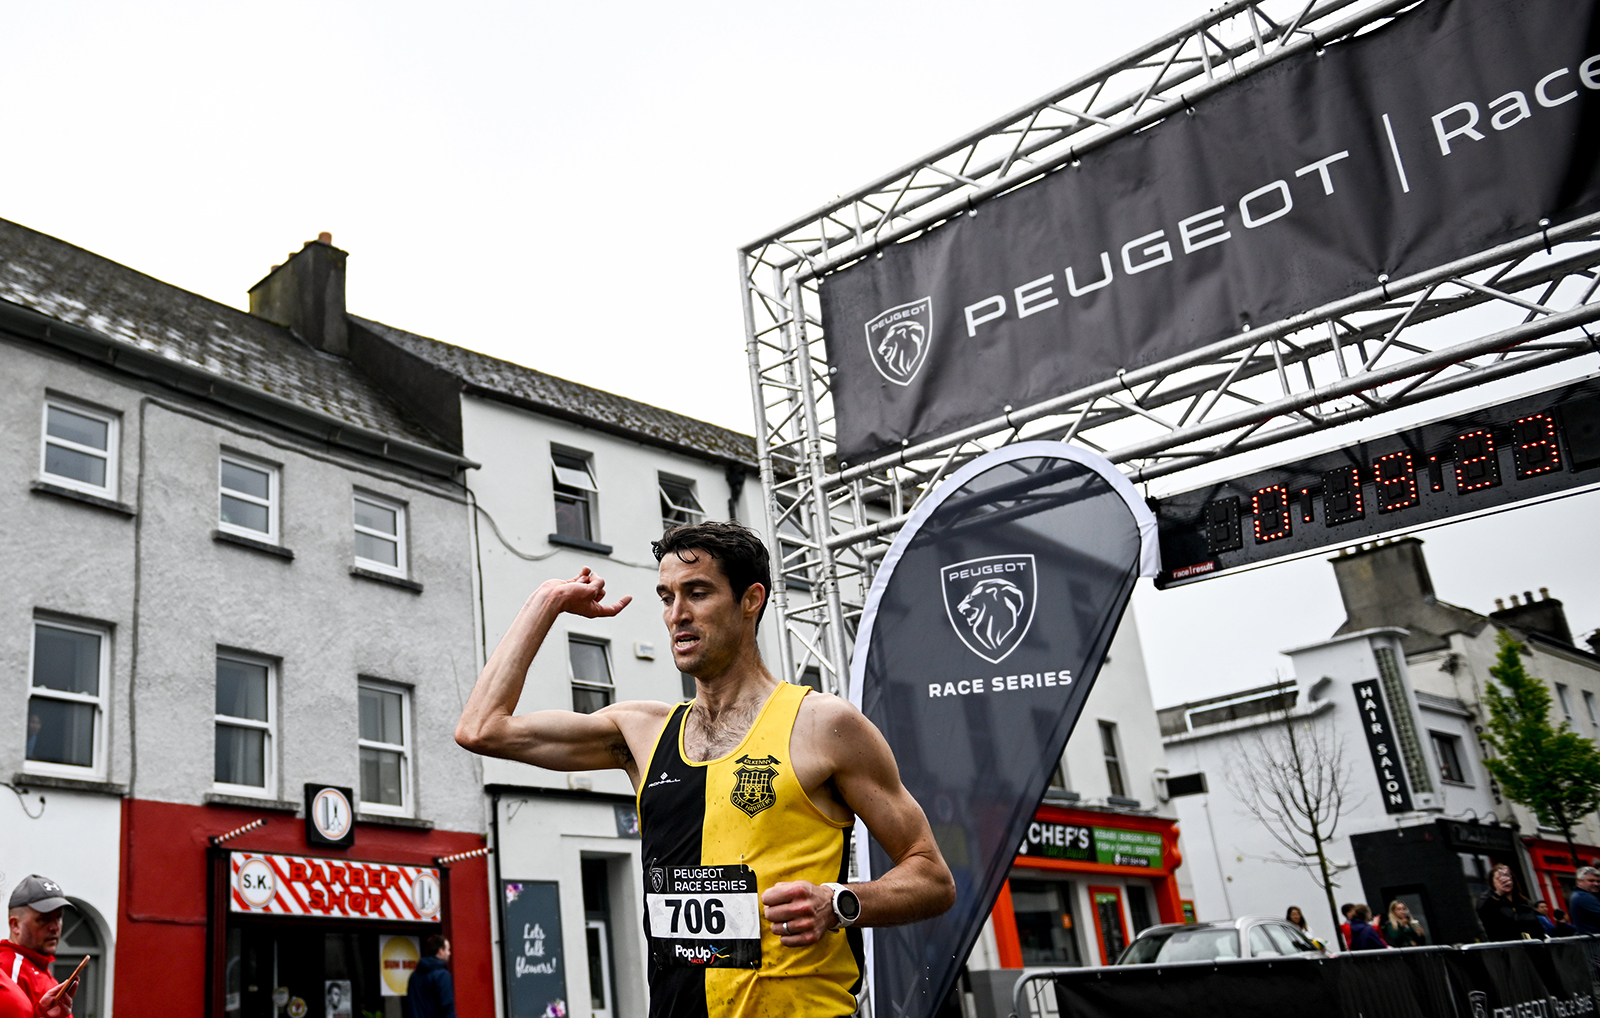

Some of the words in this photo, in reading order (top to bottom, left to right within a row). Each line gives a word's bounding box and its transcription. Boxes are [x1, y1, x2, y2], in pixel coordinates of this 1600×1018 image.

[964, 150, 1350, 338] PEUGEOT
[871, 304, 927, 333] PEUGEOT
[949, 562, 1027, 582] PEUGEOT
[928, 679, 985, 697] RACE
[991, 670, 1072, 692] SERIES
[1360, 686, 1383, 734] HAIR
[1376, 743, 1403, 805] SALON
[1028, 821, 1090, 850] CHEF'S
[243, 874, 271, 890] S.K.
[289, 863, 401, 890] BARBER
[674, 868, 724, 879] PEUGEOT
[674, 881, 702, 891] RACE
[704, 880, 747, 891] SERIES
[309, 889, 385, 913] SHOP
[664, 898, 726, 935] 706
[675, 944, 695, 961] Pop
[695, 946, 711, 962] Up
